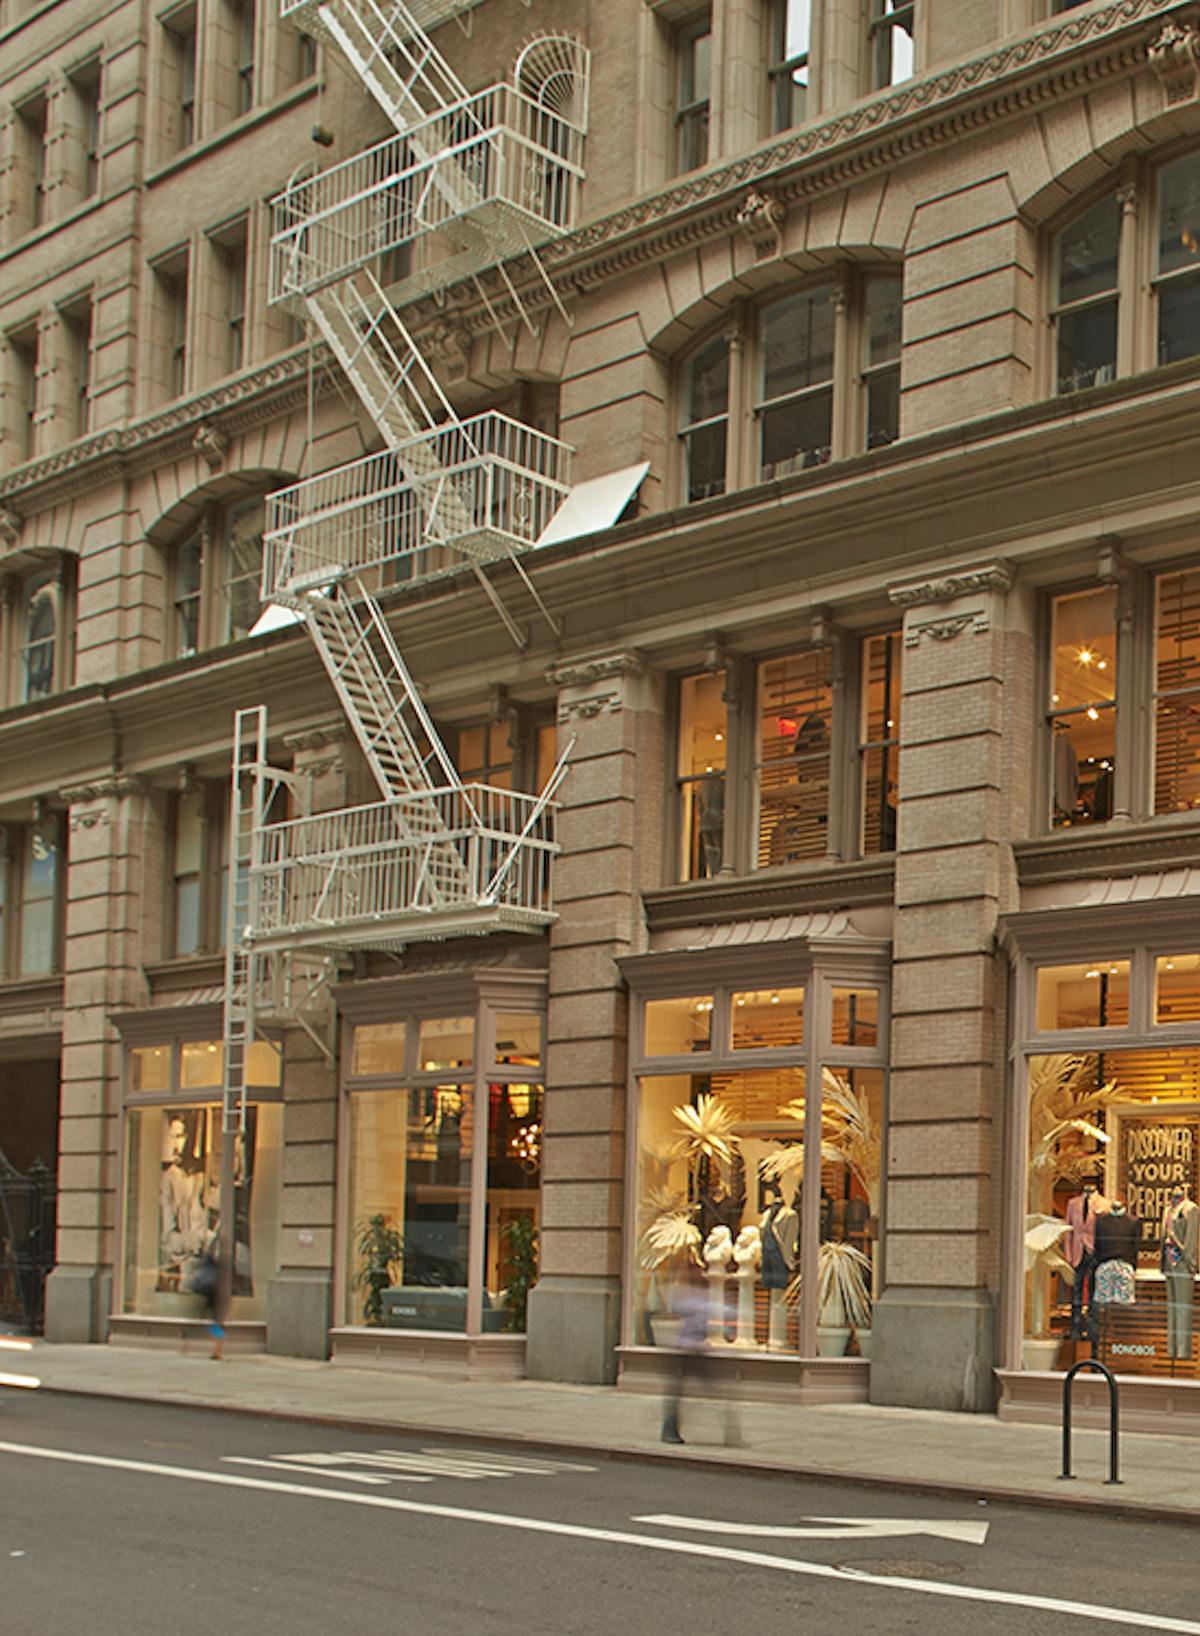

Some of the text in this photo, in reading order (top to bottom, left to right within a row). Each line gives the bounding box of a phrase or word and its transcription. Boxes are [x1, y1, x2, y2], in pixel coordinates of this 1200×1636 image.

[1127, 1127, 1192, 1163] DISCOVER
[1133, 1163, 1185, 1182] YOUR
[1127, 1183, 1192, 1218] PERFET
